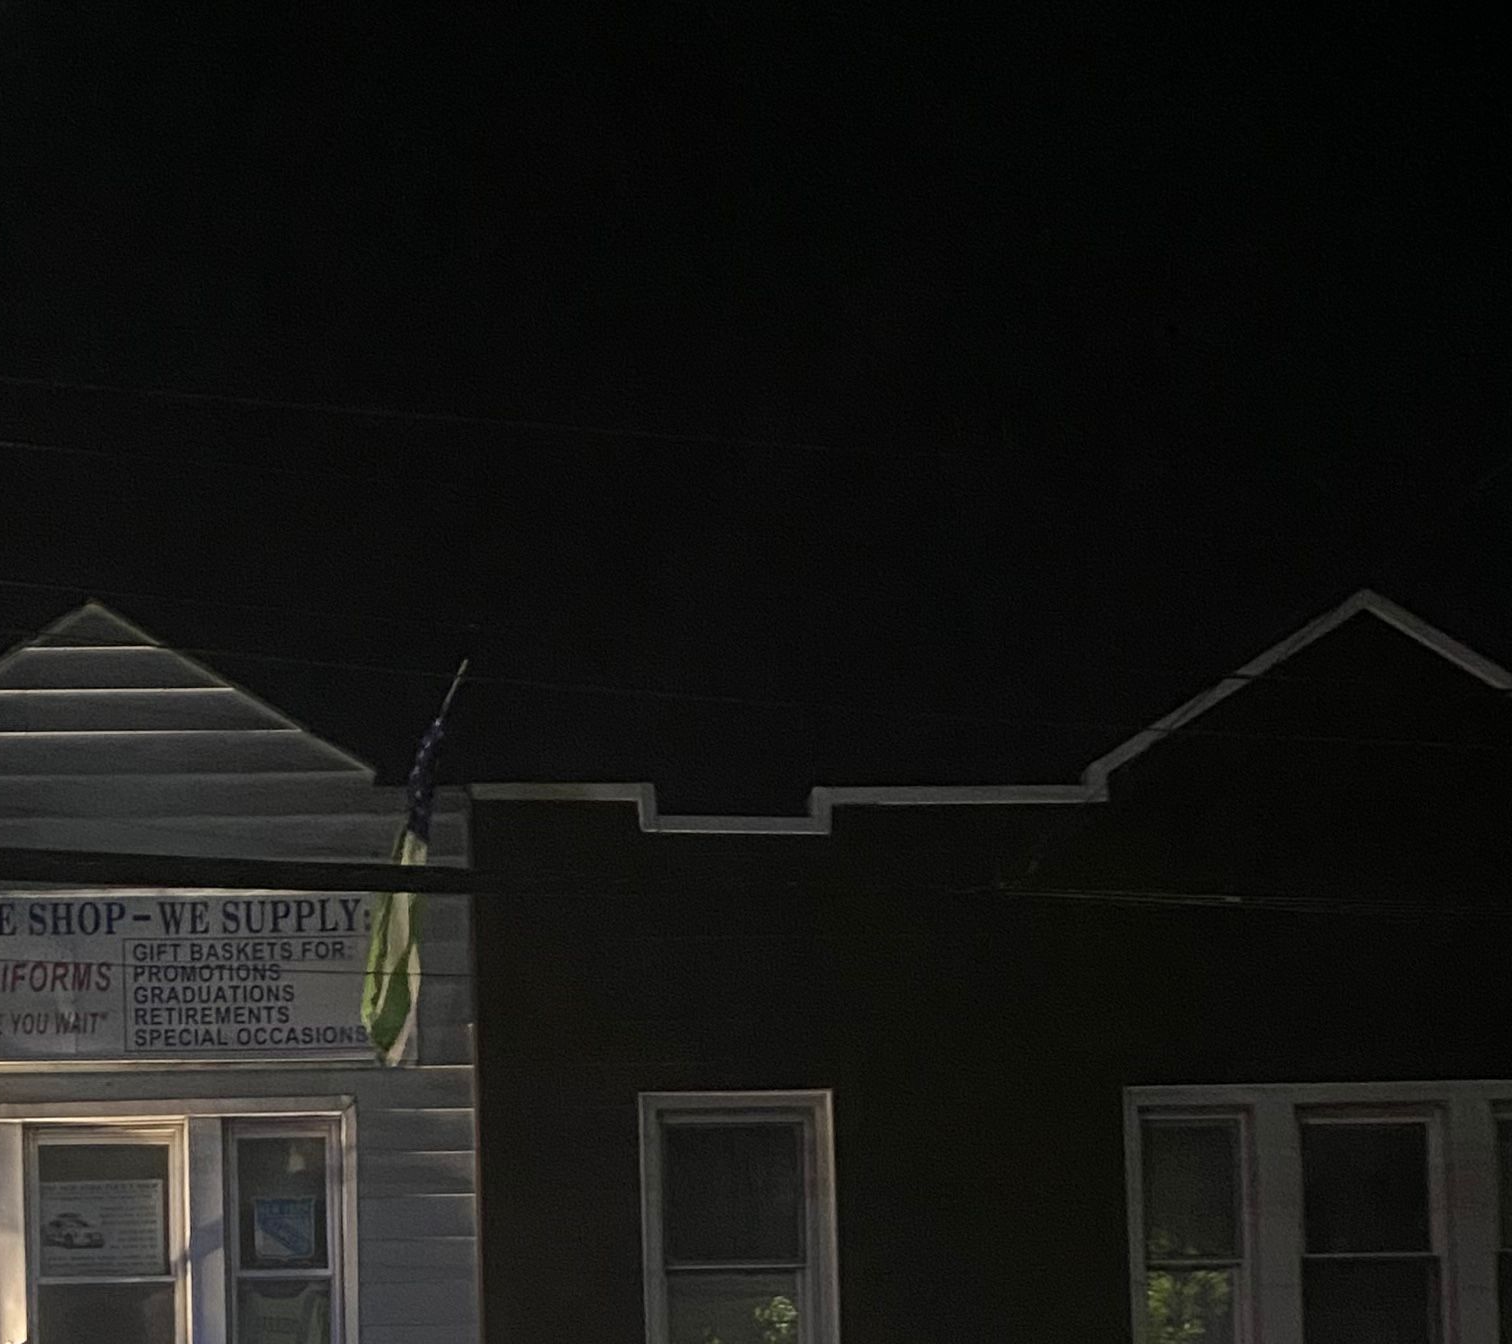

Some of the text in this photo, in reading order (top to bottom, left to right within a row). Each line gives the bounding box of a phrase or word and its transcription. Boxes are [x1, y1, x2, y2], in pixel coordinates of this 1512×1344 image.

[28, 902, 125, 938] SHOP
[158, 902, 209, 936] WE
[222, 898, 371, 934] SUPPLY:
[132, 944, 180, 962] GIFT
[190, 943, 293, 961] BASKETS
[133, 965, 281, 983] PROMOTIONS
[134, 985, 295, 1004] GRADUATIONS
[12, 1013, 48, 1034] YOU
[134, 1006, 291, 1025] RETIREMENTS
[134, 1025, 369, 1047] SPECIAL OCCASIONS
